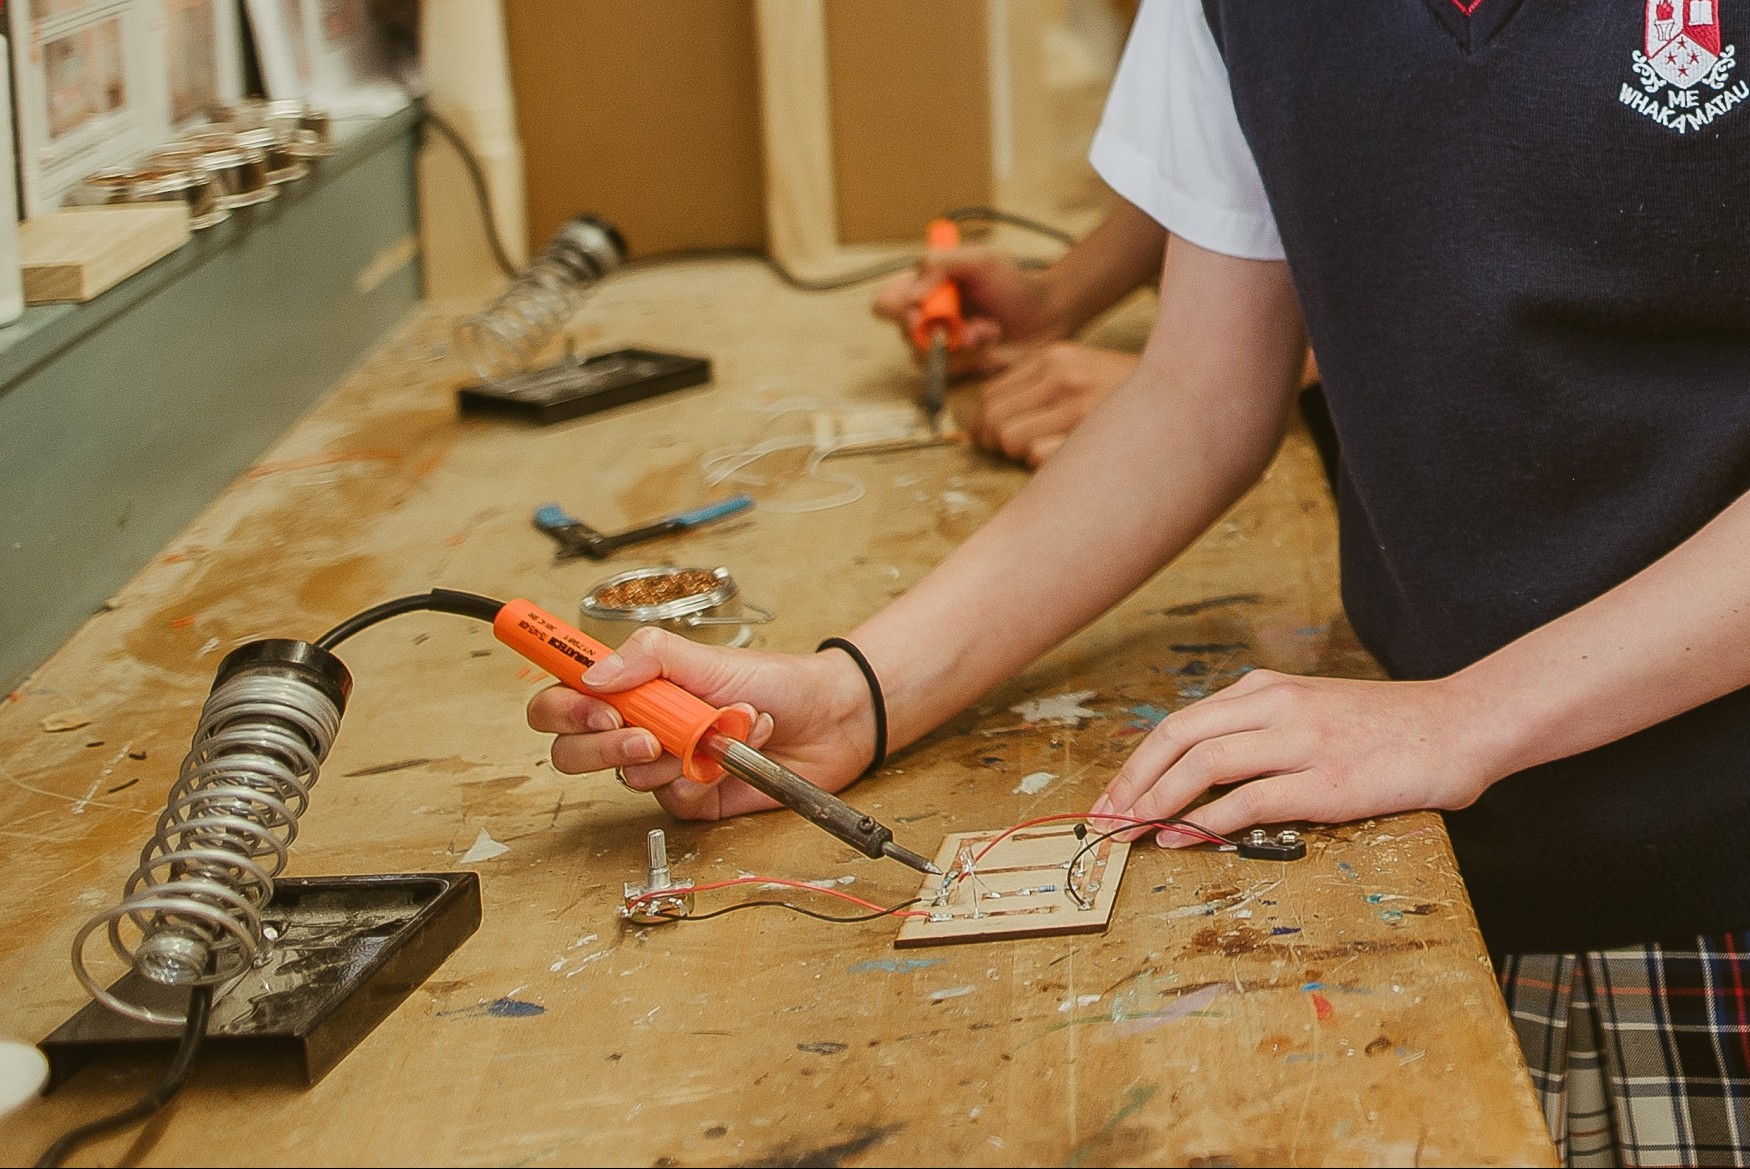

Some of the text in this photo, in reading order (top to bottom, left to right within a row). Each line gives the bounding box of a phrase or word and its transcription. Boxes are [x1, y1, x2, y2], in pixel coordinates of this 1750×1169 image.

[1618, 80, 1750, 134] WHAKAMATAU
[1667, 89, 1700, 109] ME
[547, 636, 596, 669] DURATECH
